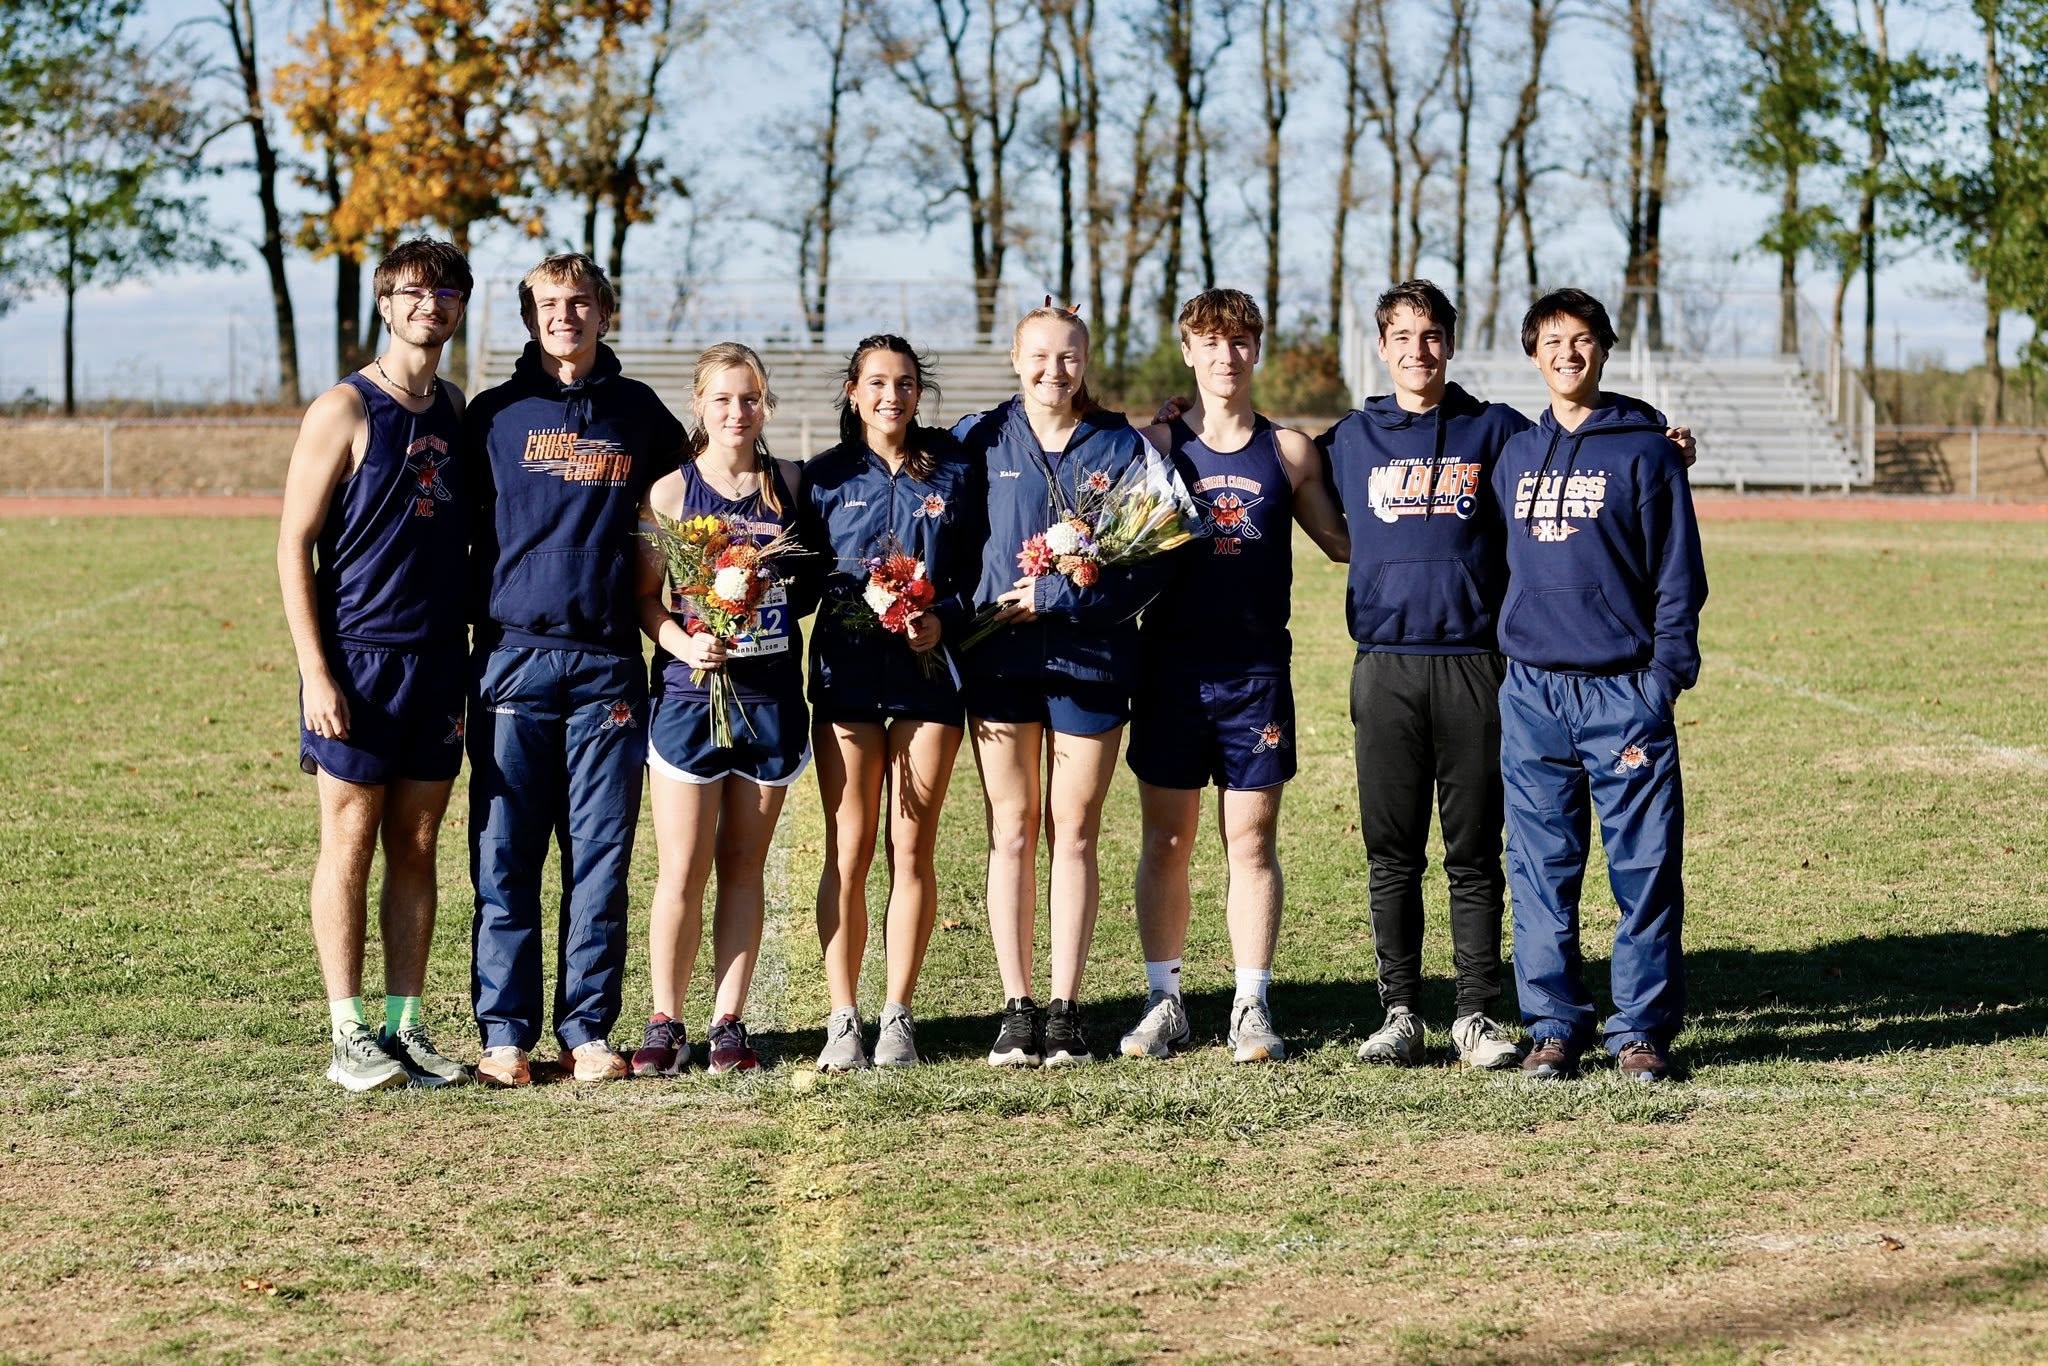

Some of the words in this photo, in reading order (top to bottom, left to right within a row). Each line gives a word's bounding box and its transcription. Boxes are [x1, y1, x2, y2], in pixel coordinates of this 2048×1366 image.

[523, 433, 578, 462] CROSS
[564, 454, 633, 482] COUNTRY
[1389, 458, 1424, 467] CENTRAL
[1524, 469, 1605, 477] WILDATS
[1193, 475, 1228, 494] CENTRAL
[1227, 475, 1262, 496] CLARION
[1368, 463, 1482, 508] WILDCATS
[1516, 475, 1607, 501] CROSS
[415, 498, 434, 517] XC
[1538, 519, 1568, 542] XC
[1214, 537, 1241, 554] XC
